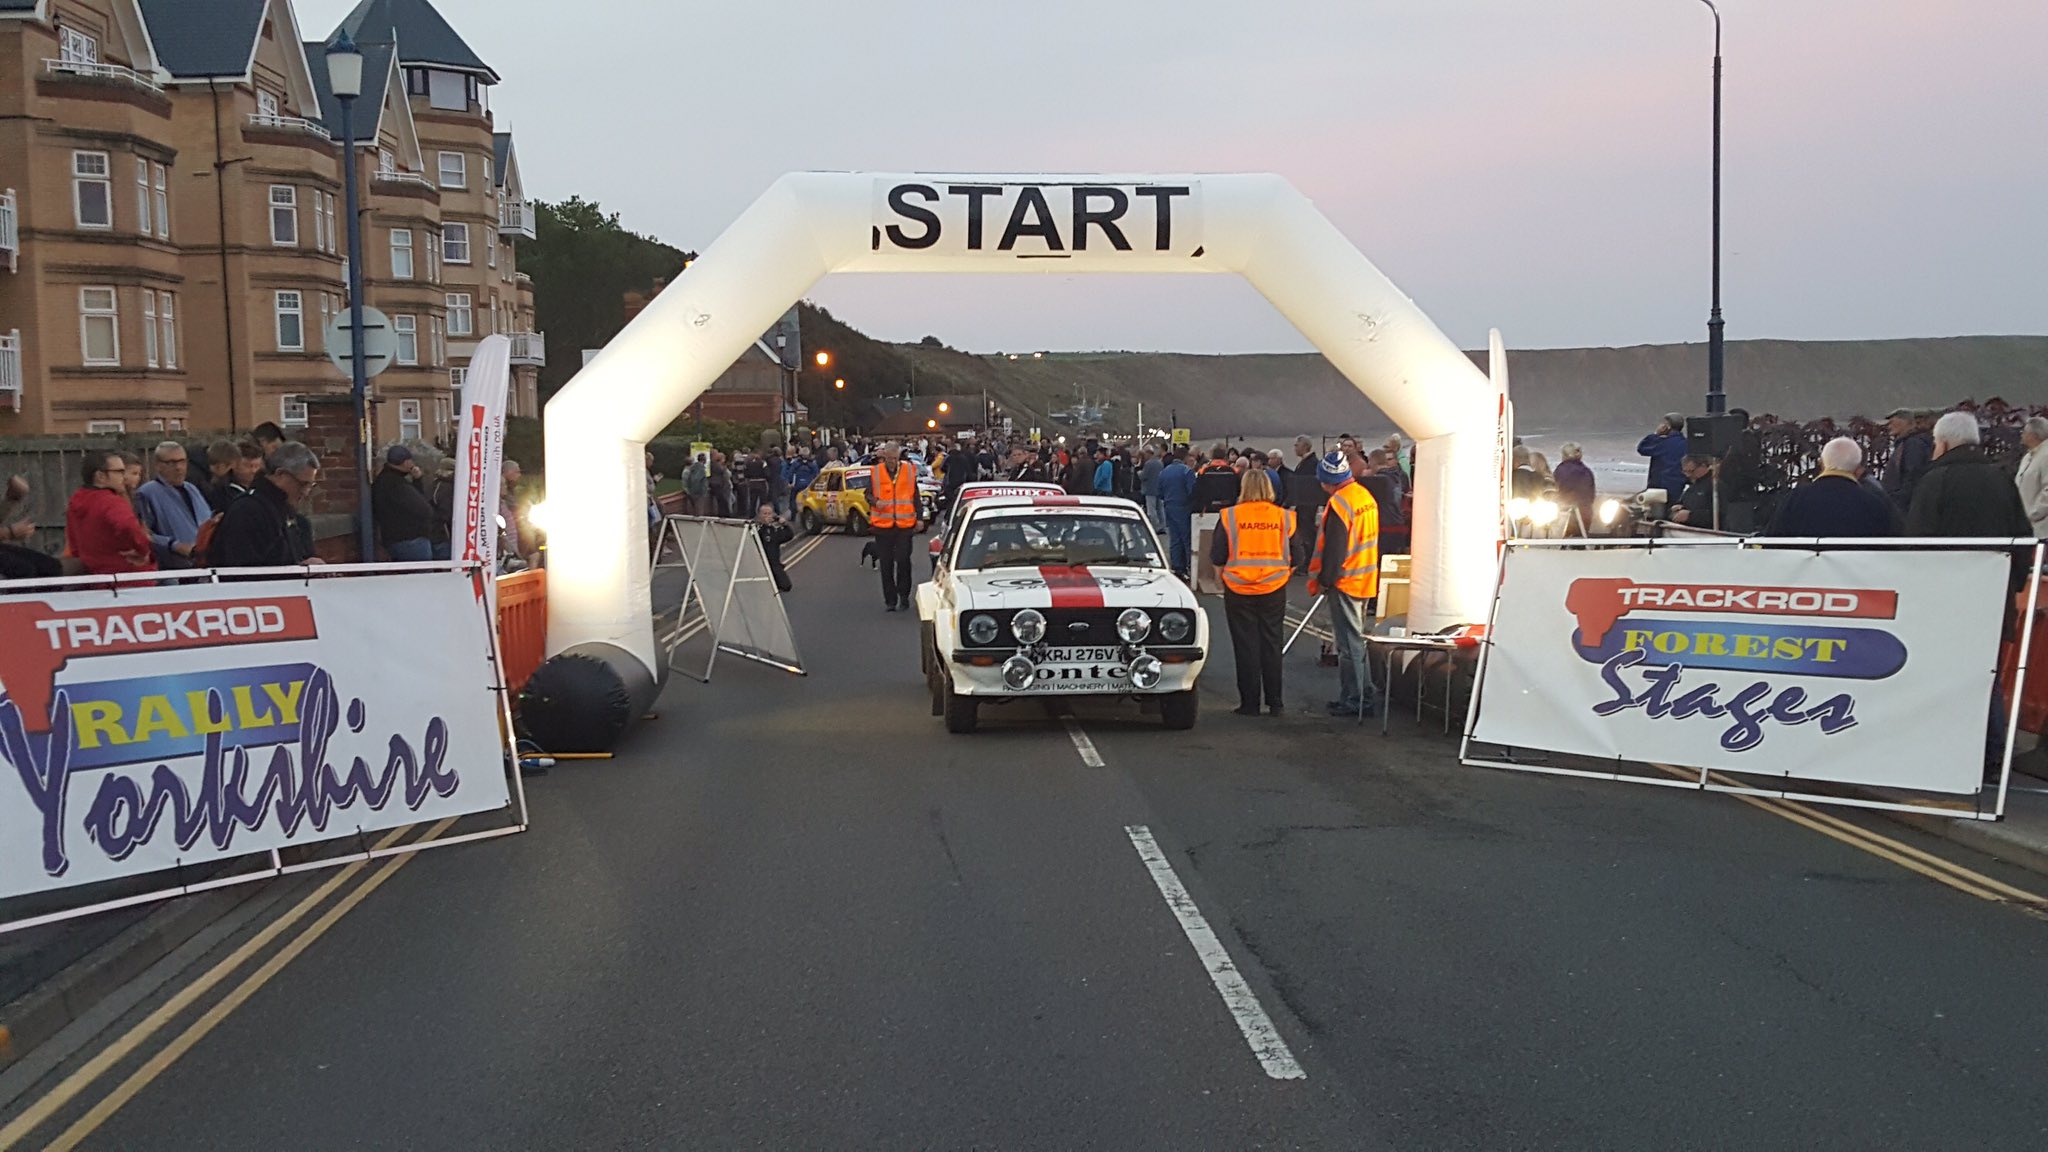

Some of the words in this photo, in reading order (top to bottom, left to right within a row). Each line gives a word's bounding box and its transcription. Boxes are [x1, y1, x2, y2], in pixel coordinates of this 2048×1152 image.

[885, 183, 1190, 251] START
[991, 487, 1041, 497] MINTEX
[1617, 587, 1859, 613] TRACKROD
[36, 604, 285, 650] TRACKROD
[1044, 649, 1072, 661] KRJ
[1076, 648, 1115, 660] 276V
[1622, 629, 1848, 663] FOREST
[1035, 664, 1128, 680] onte
[1057, 682, 1105, 691] MACHINERY
[71, 680, 305, 749] RALLY
[1592, 648, 1859, 753] Stages
[0, 665, 459, 877] Yorkshire
